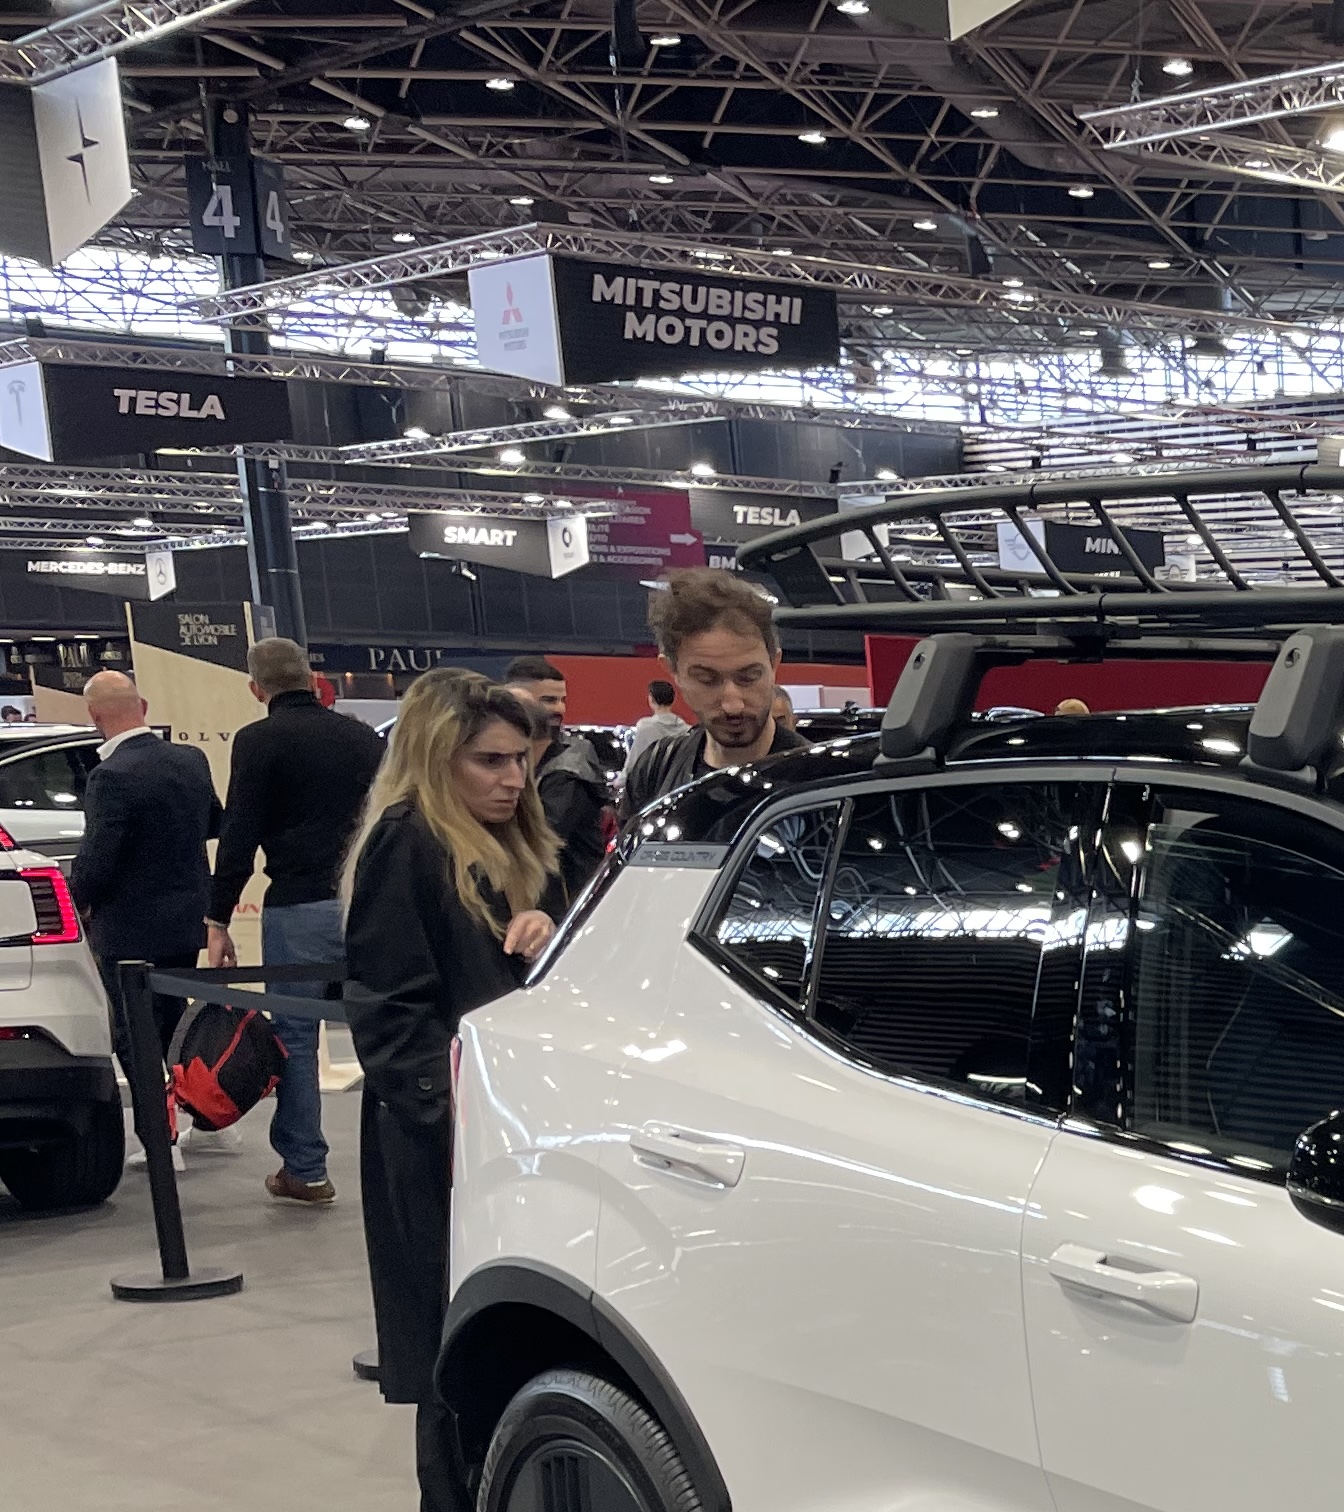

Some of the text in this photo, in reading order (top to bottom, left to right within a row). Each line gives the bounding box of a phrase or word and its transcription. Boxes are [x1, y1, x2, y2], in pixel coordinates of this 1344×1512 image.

[202, 185, 241, 239] 4
[266, 190, 285, 244] 4
[591, 273, 804, 326] MITSUBISHI
[623, 311, 780, 356] MOTORS
[113, 388, 226, 421] TESLA
[732, 504, 801, 527] TESLA
[443, 525, 518, 548] SMART
[1084, 536, 1122, 555] MIN
[27, 560, 146, 576] MERCEDES-BENZ
[708, 554, 744, 571] BM
[177, 613, 210, 624] SALON
